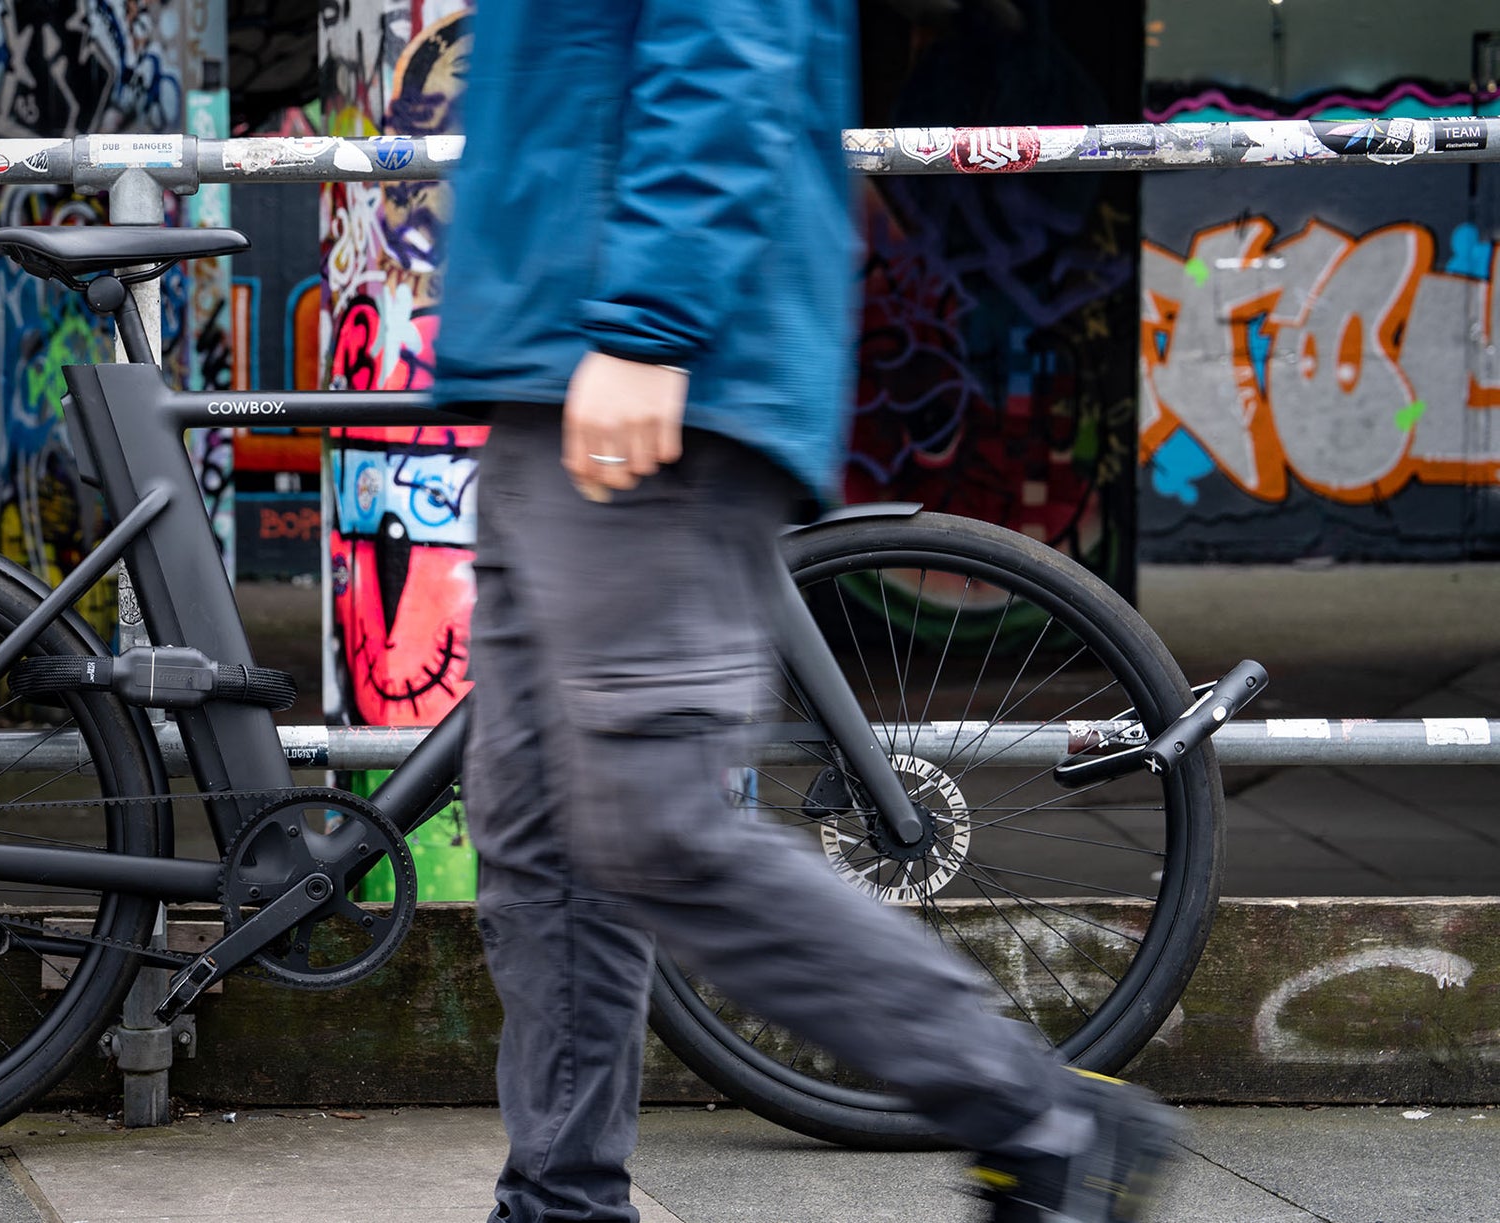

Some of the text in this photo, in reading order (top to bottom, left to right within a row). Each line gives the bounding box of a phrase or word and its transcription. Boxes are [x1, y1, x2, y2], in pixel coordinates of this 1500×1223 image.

[1442, 126, 1481, 139] TEAM
[102, 142, 173, 151] DUB BANGERS
[207, 401, 286, 415] COWBOY.
